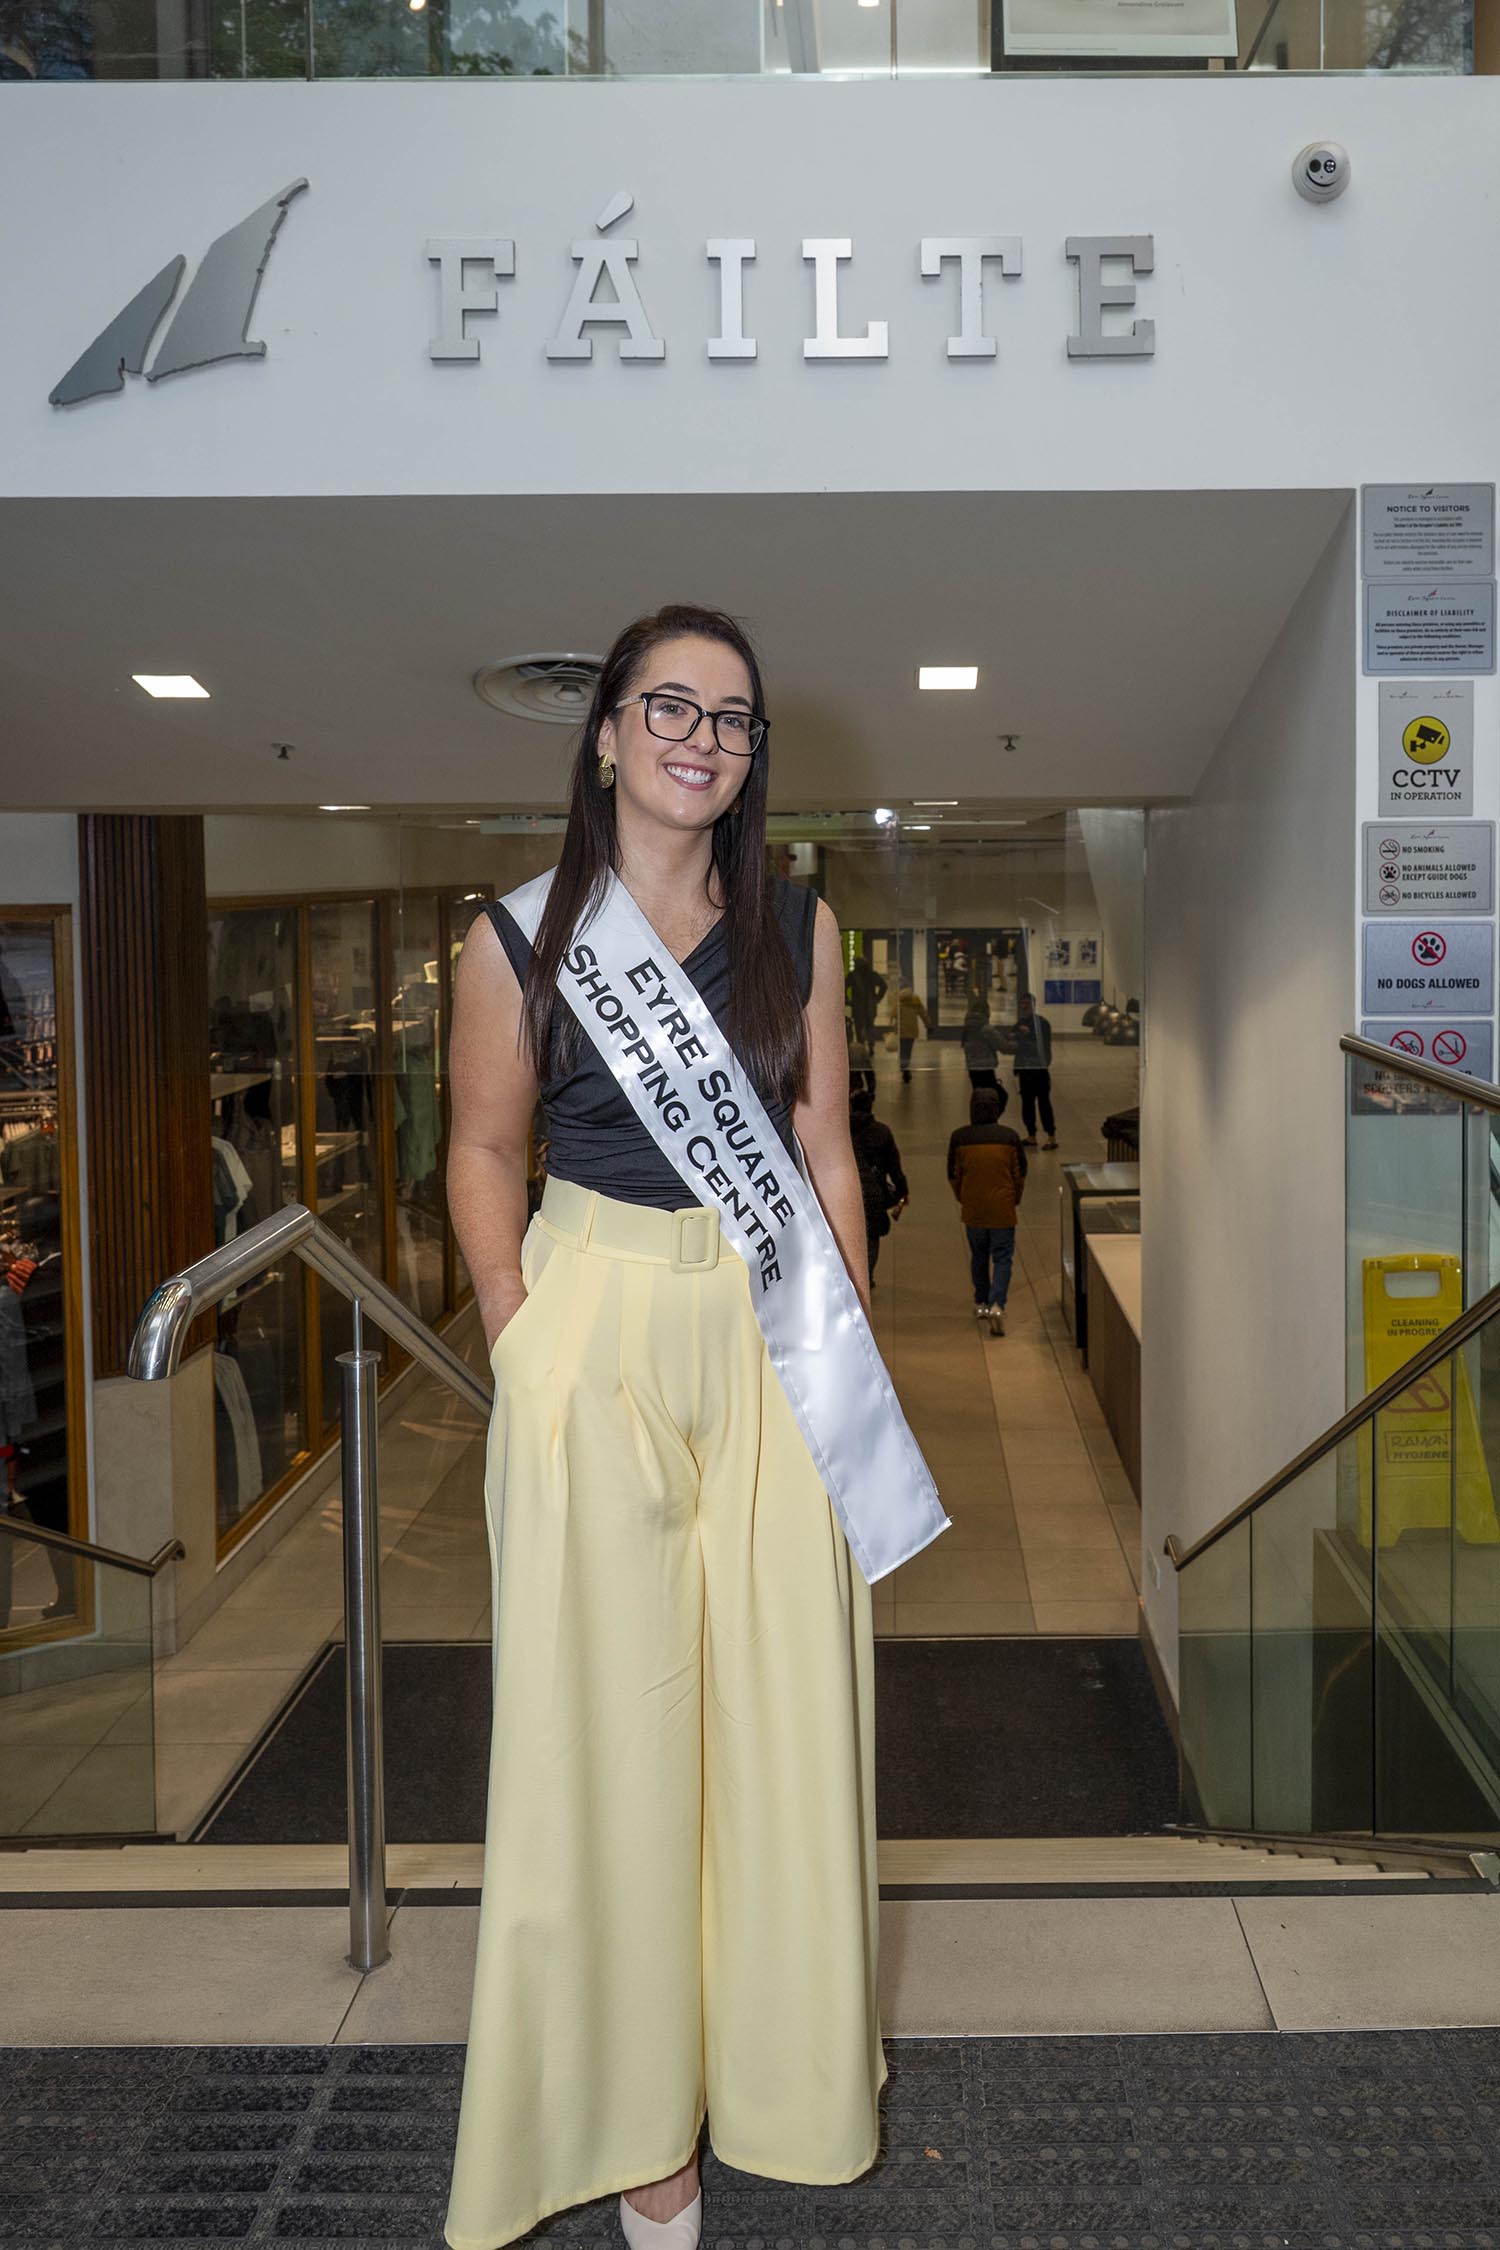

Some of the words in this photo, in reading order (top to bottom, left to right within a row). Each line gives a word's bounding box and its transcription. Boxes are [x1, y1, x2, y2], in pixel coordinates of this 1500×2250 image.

[426, 191, 1156, 360] FÁILTE
[1386, 505, 1417, 513] NOTICE
[1392, 769, 1461, 788] CCTV
[1390, 792, 1401, 800] IN
[1403, 792, 1462, 800] OPERATION
[1377, 978, 1393, 989] NO
[1396, 978, 1425, 989] DOGS
[1428, 978, 1480, 989] ALLOWED
[624, 957, 710, 1070] EYRE
[697, 1069, 795, 1228] SQUARE
[563, 944, 692, 1133] SHOPPING
[686, 1135, 784, 1293] CENTRE
[1391, 1318, 1440, 1327] CLEANING
[1387, 1329, 1398, 1337] IN
